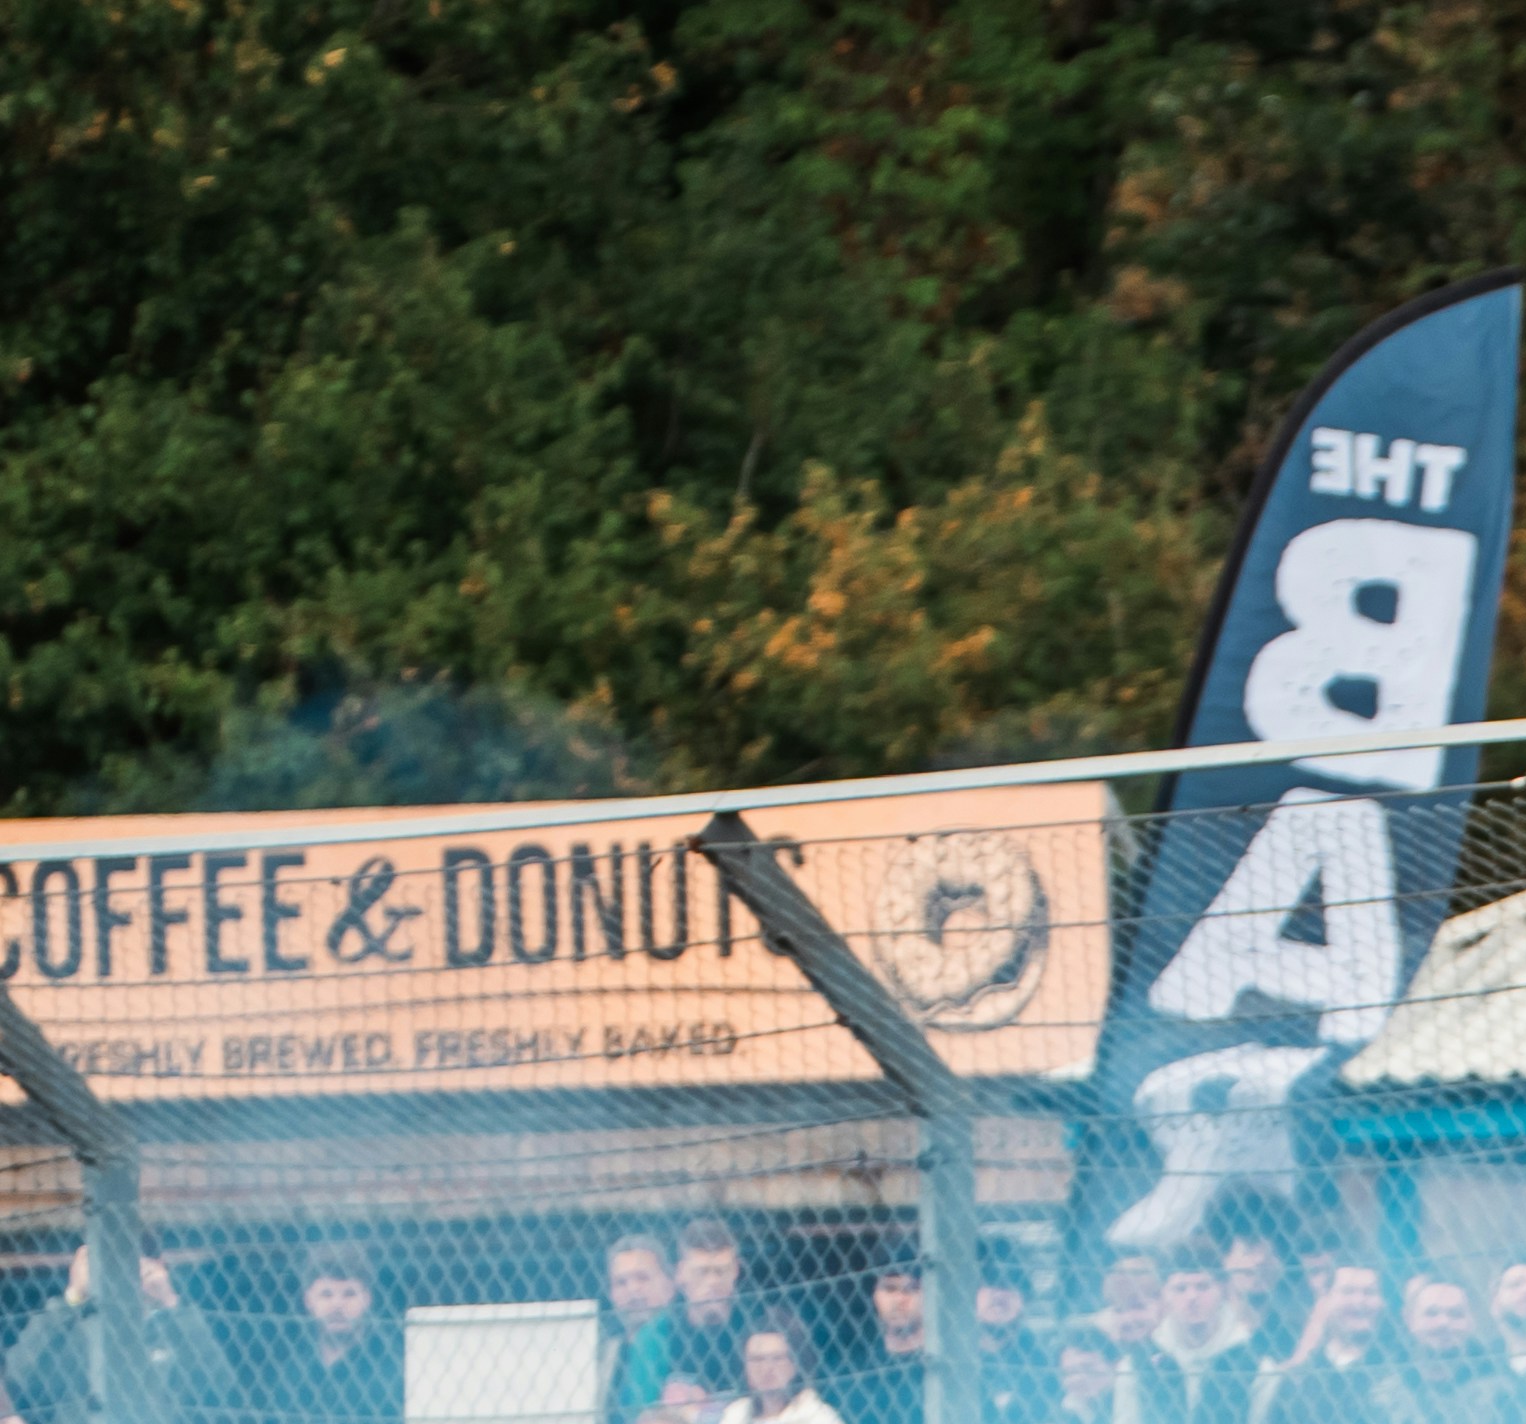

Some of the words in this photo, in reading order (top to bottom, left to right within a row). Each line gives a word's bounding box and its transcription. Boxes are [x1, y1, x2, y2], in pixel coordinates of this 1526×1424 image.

[443, 835, 802, 967] DONU
[57, 1039, 205, 1075] RESHLY
[415, 1026, 587, 1068] FRESHLY
